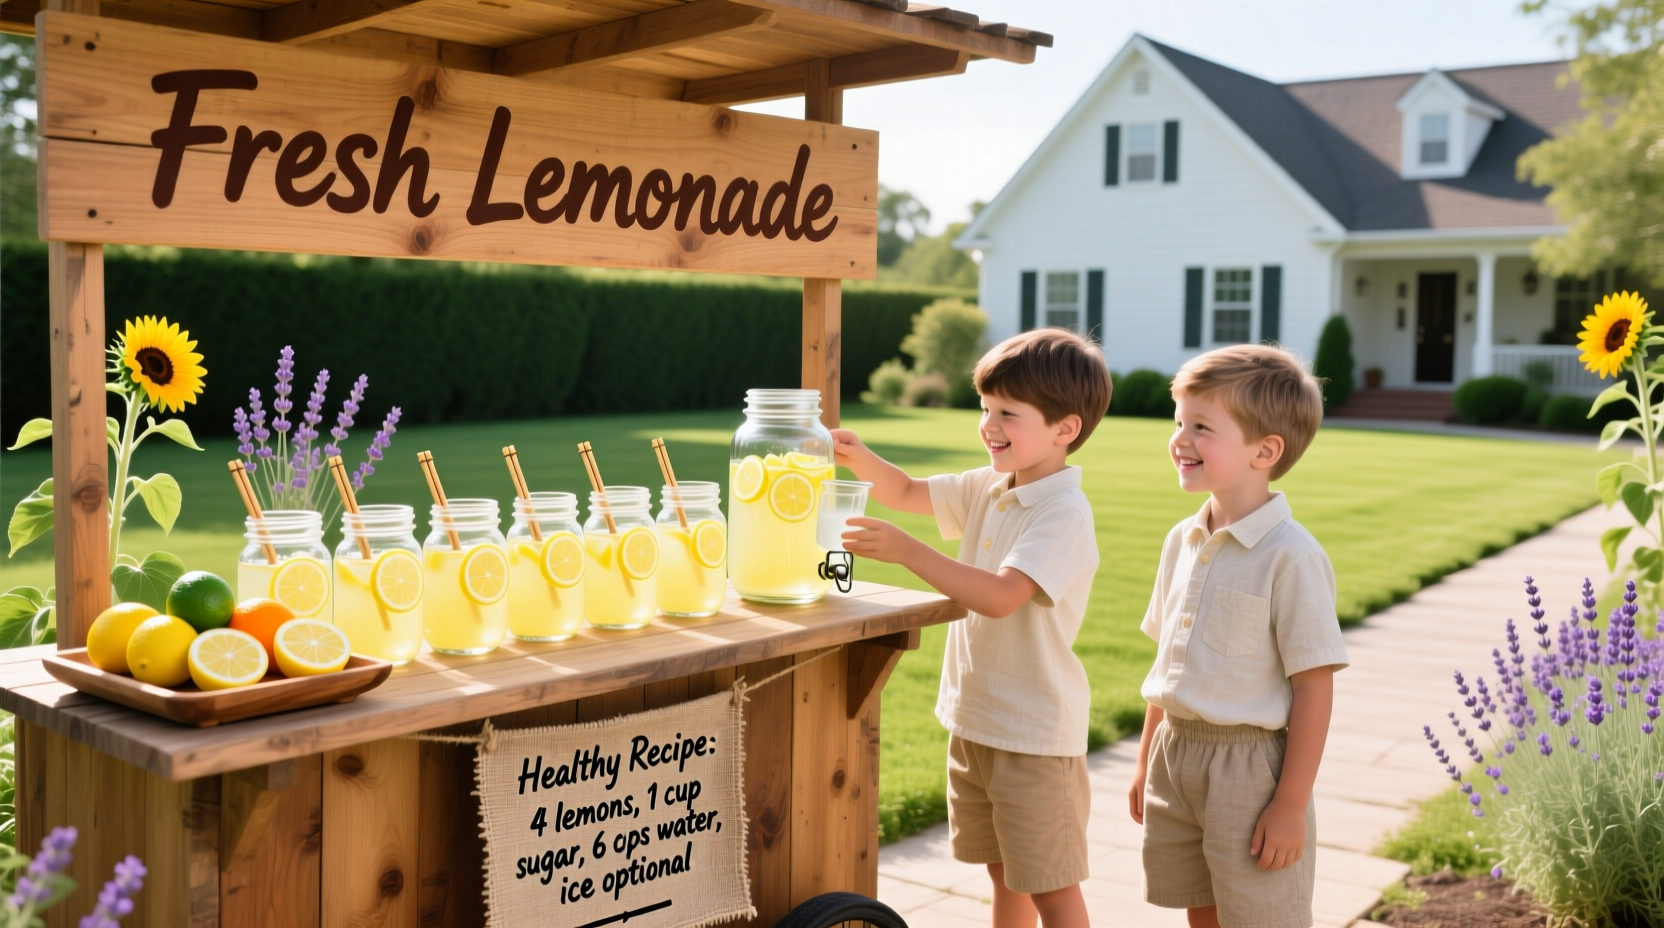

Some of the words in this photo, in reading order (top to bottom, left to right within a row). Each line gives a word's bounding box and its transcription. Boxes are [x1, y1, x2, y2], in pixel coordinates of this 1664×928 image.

[151, 68, 440, 218] Fresh
[465, 105, 839, 243] Lemonade
[518, 744, 621, 795] Healthy
[629, 732, 716, 772] Recipe:
[530, 806, 547, 837] 4
[555, 794, 640, 832] lemons,
[647, 782, 658, 810] 1
[664, 780, 701, 810] cup
[516, 845, 585, 885] sugar,
[592, 830, 606, 859] 6
[657, 809, 722, 840] water,
[560, 877, 595, 904] ice
[602, 841, 692, 900] optional
